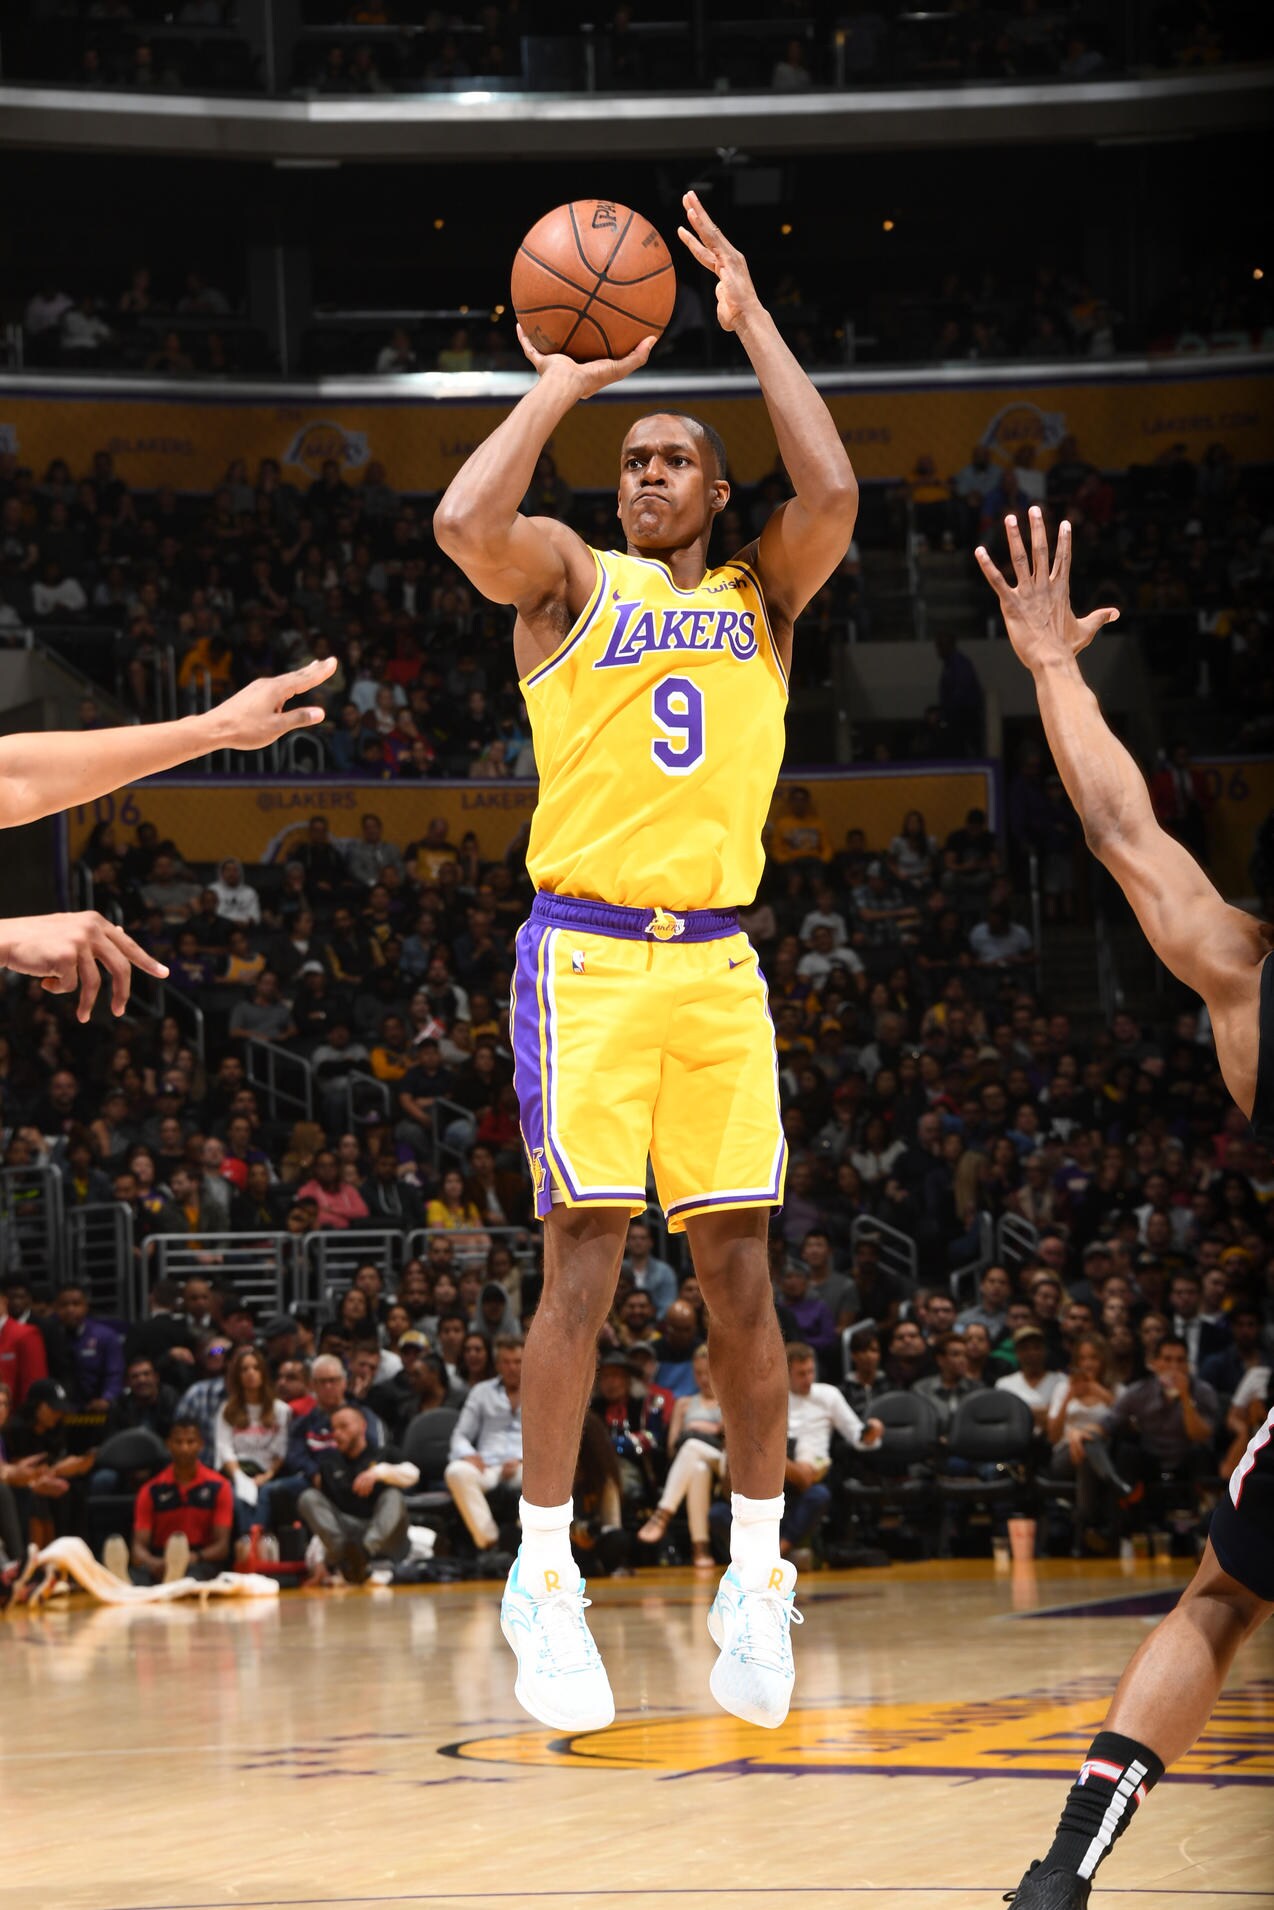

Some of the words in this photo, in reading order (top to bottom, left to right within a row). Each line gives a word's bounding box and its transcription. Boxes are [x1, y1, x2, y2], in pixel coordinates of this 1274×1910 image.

[701, 577, 747, 594] wish
[592, 599, 759, 669] LAKERS
[651, 675, 706, 776] 9
[257, 791, 357, 812] @LAKERS
[544, 1570, 560, 1592] R
[767, 1568, 784, 1591] R
